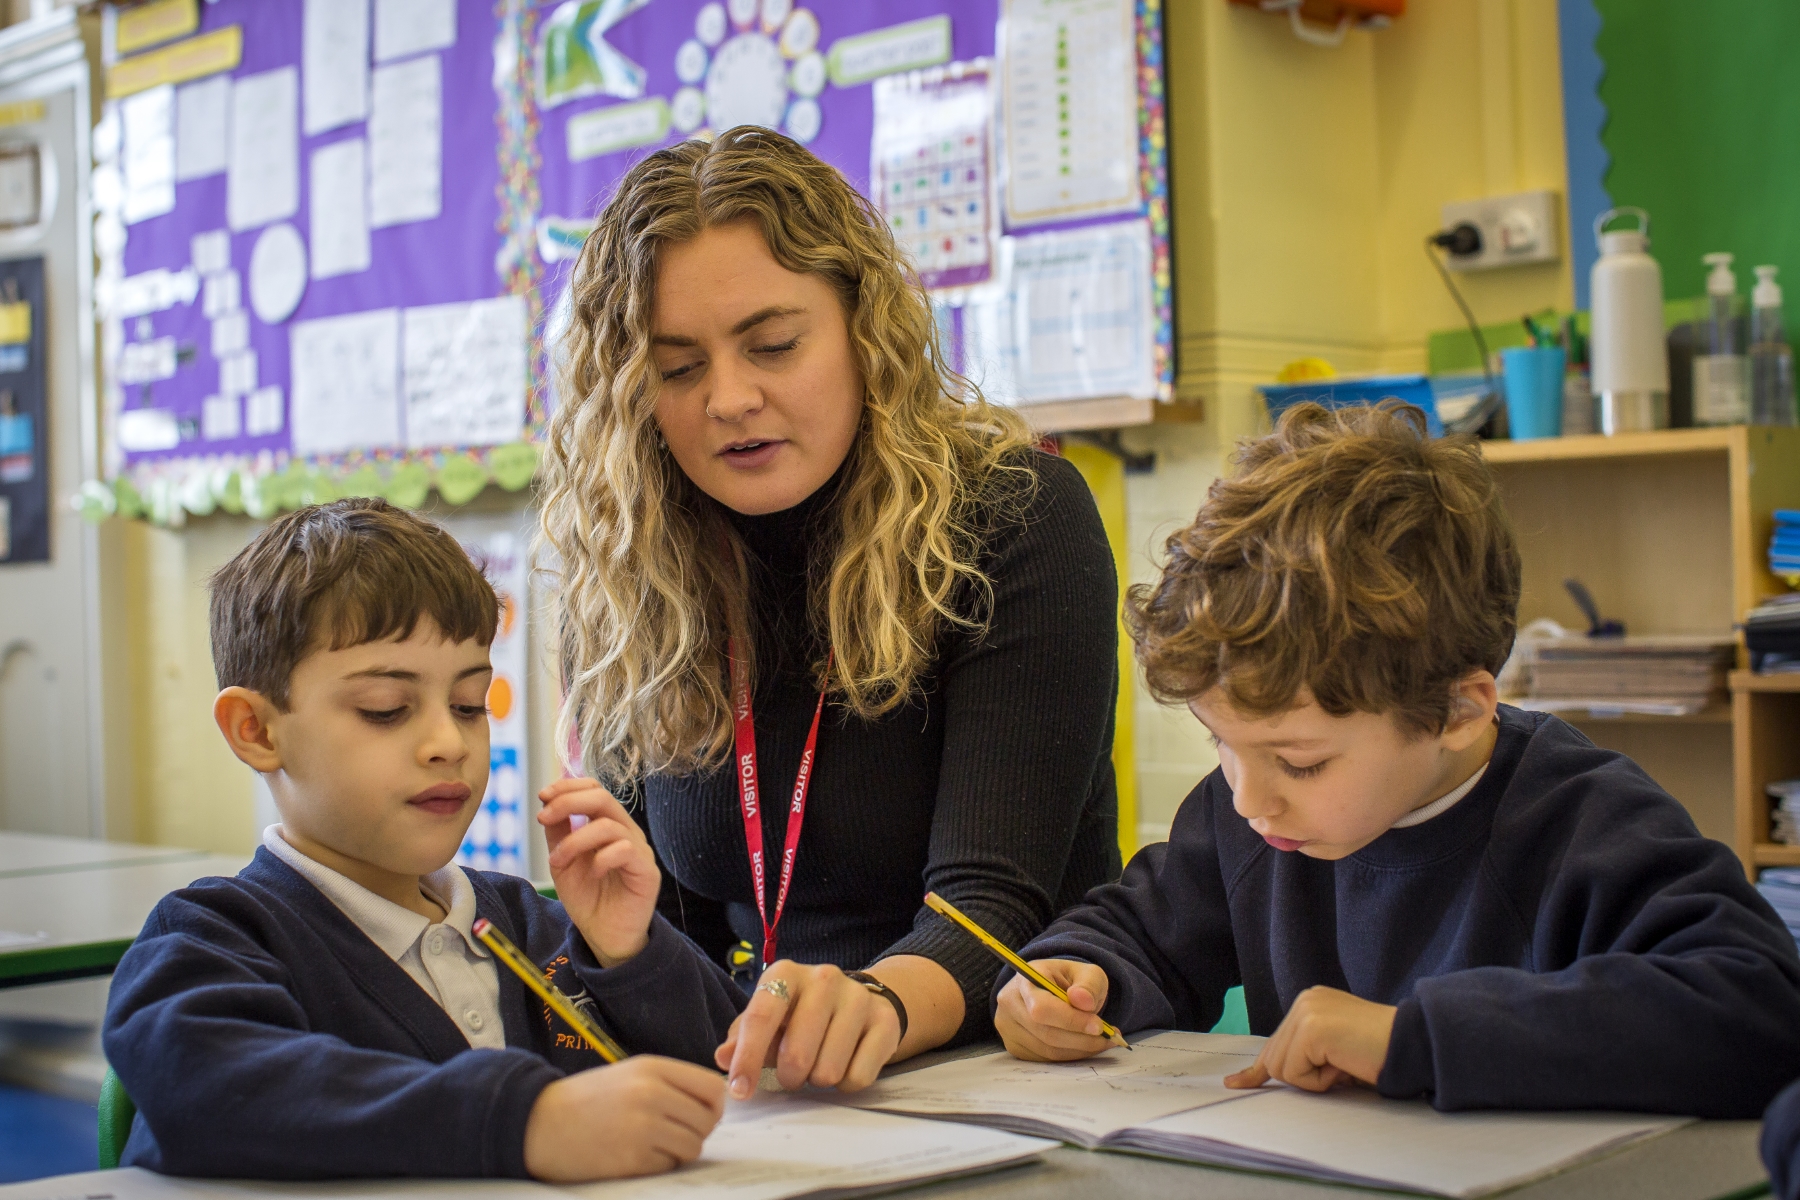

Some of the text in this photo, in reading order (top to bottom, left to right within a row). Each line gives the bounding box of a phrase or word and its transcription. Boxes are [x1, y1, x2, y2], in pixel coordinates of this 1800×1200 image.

[741, 752, 757, 819] VISITOR
[792, 749, 812, 813] VISITOR
[776, 848, 793, 911] VISITOR
